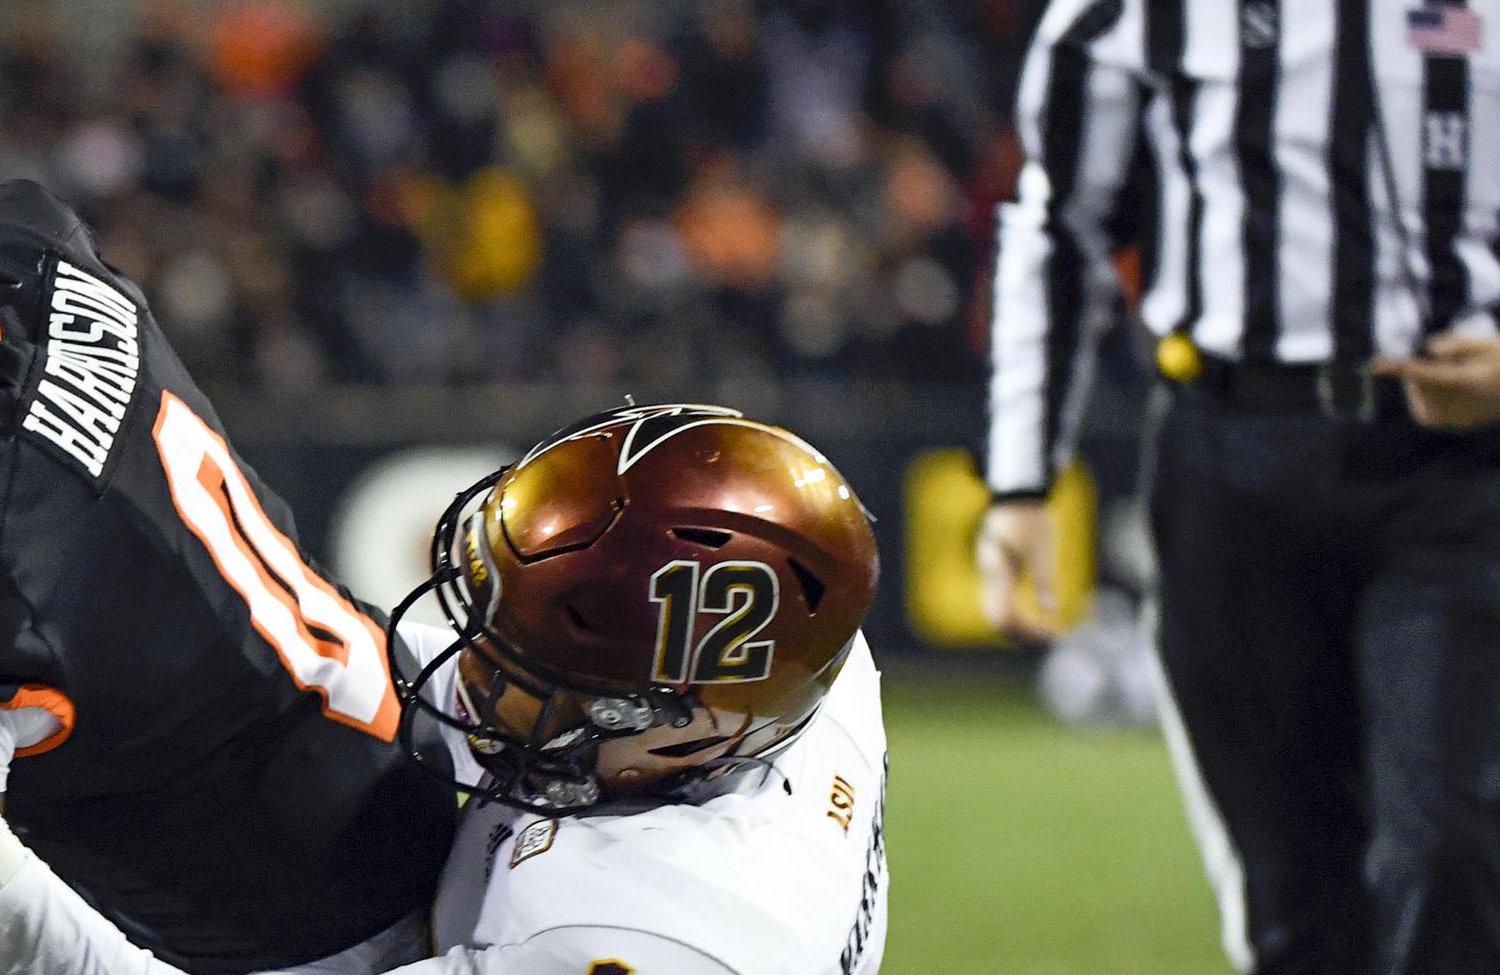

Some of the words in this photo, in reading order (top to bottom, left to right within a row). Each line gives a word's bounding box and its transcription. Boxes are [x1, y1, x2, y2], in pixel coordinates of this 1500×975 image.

[22, 260, 139, 478] HARRISON
[152, 389, 402, 743] 0
[649, 560, 780, 684] 12
